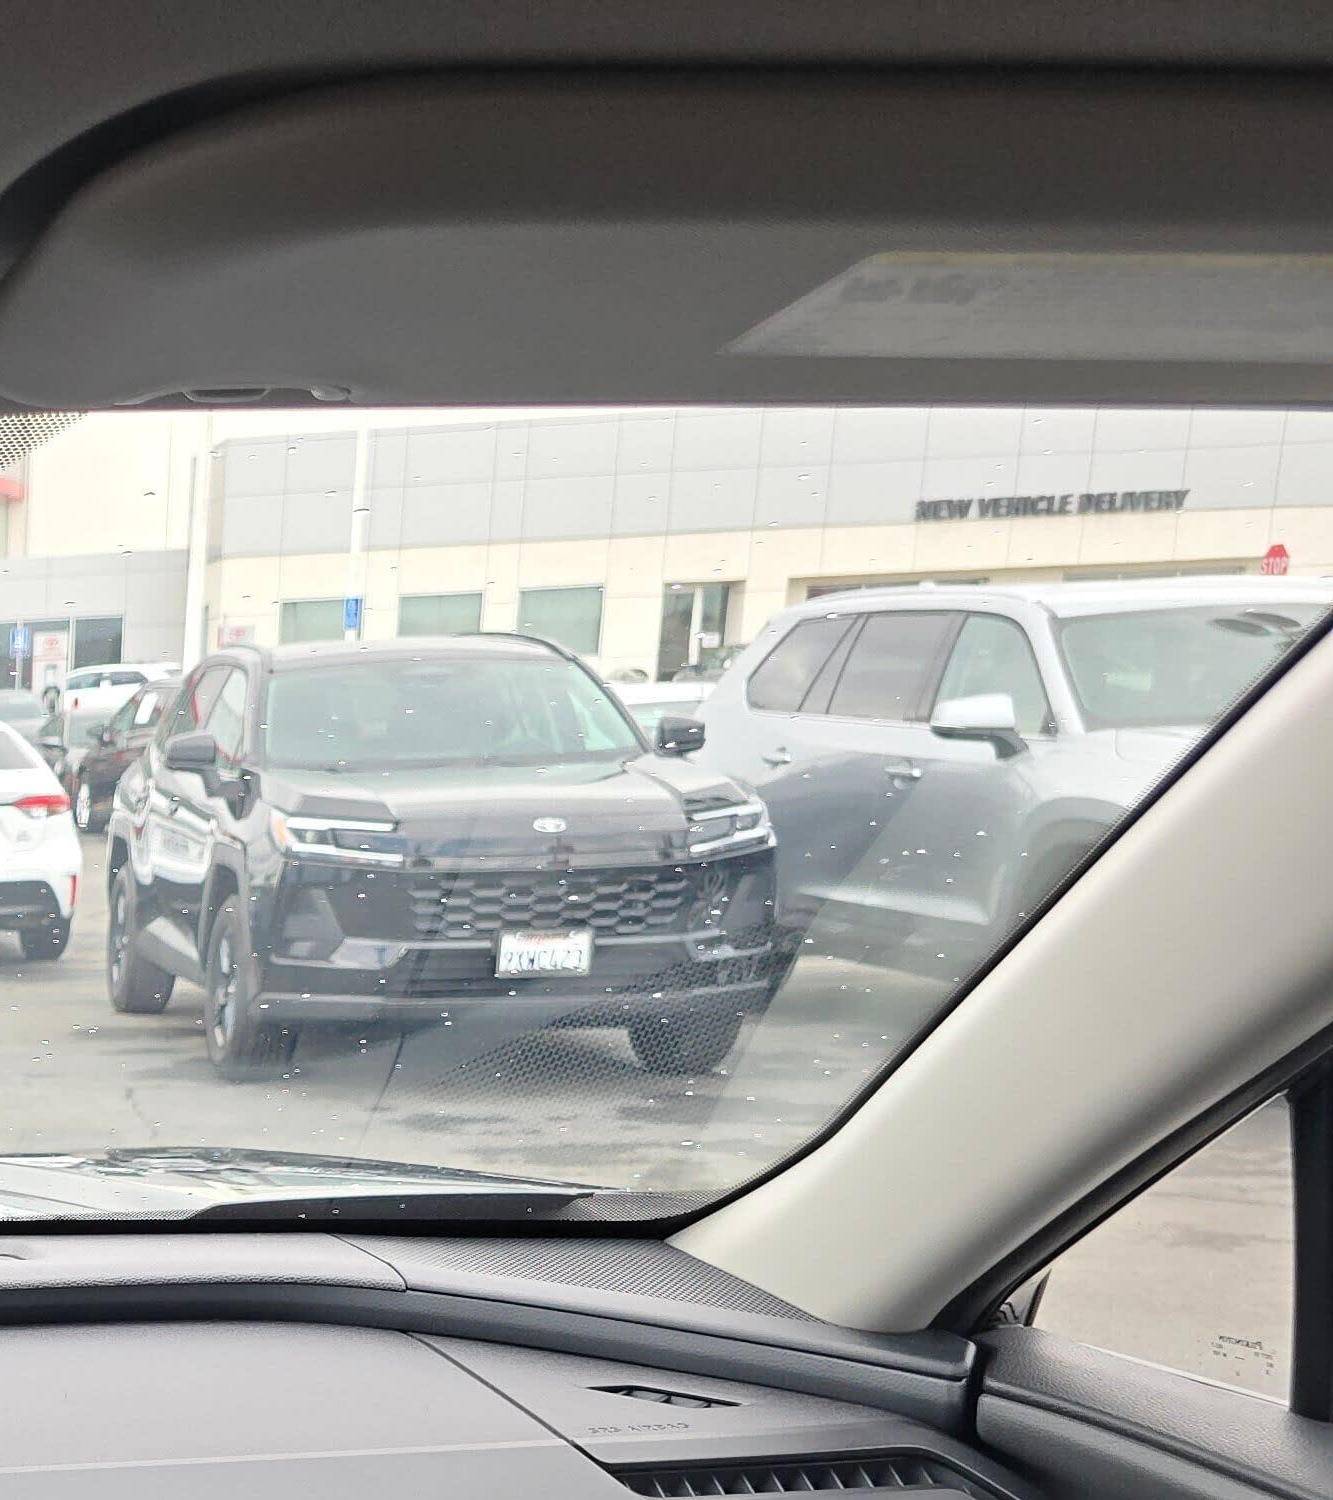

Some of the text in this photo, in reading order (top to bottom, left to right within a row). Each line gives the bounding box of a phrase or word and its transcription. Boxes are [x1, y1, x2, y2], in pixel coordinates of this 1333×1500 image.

[915, 489, 1191, 521] NEW VEHICLE DELIVERY
[1260, 557, 1288, 575] STOP
